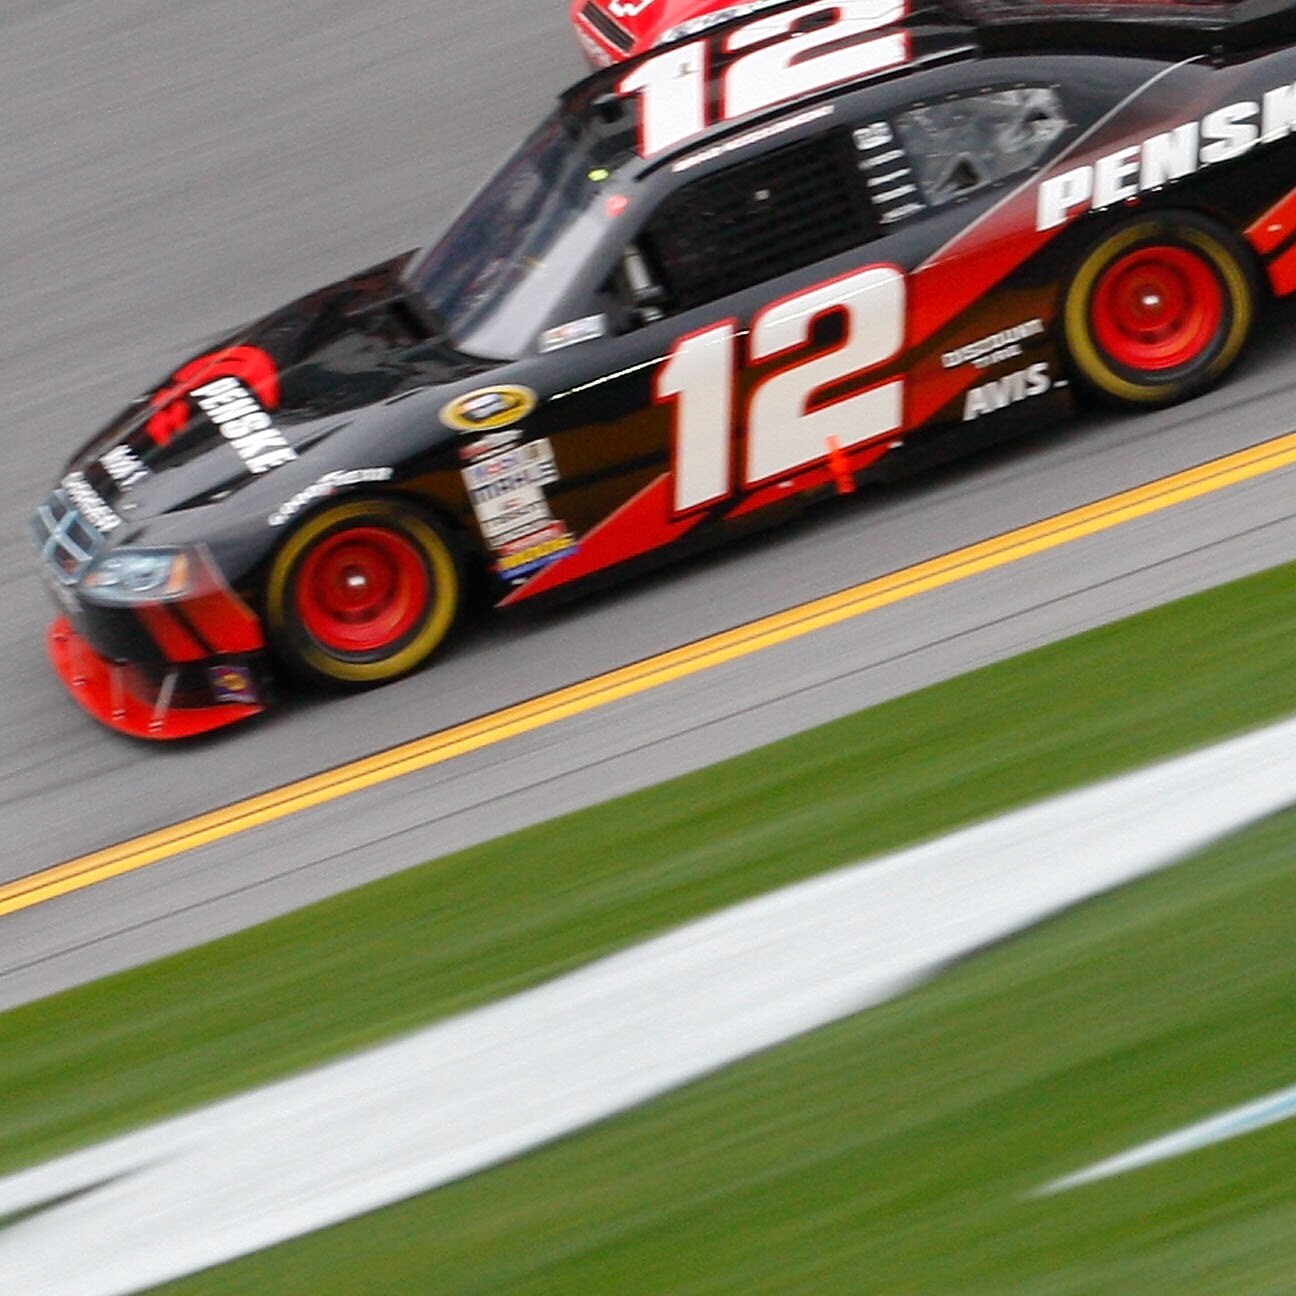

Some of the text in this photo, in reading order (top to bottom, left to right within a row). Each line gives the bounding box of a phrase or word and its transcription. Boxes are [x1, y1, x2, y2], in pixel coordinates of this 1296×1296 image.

[190, 376, 299, 474] PENSKE
[654, 263, 907, 516] 12
[963, 362, 1051, 422] AVIS
